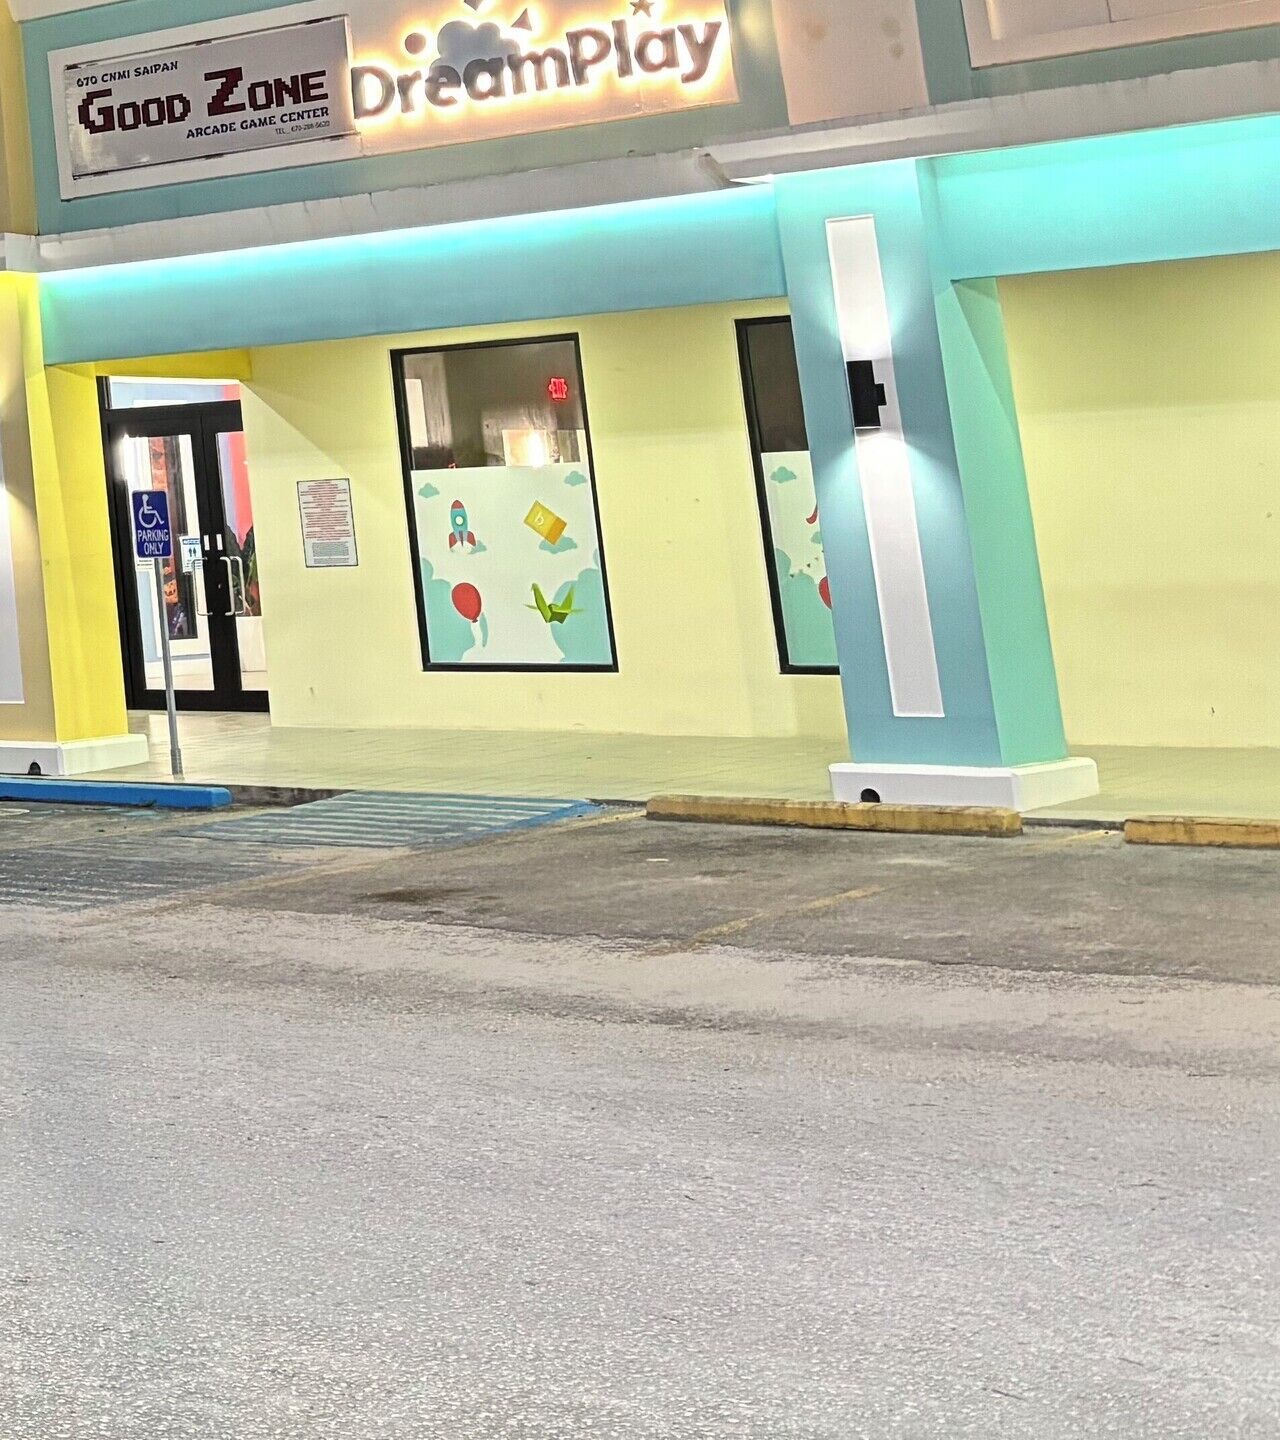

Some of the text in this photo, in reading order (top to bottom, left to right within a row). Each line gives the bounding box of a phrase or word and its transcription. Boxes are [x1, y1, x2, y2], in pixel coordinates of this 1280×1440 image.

[76, 60, 179, 88] 670 CNMI SAIPAN
[351, 19, 722, 119] DreamPlay
[186, 106, 329, 139] ARCADE GAME CENTER
[137, 529, 169, 542] PARKING
[143, 541, 165, 555] ONLY
